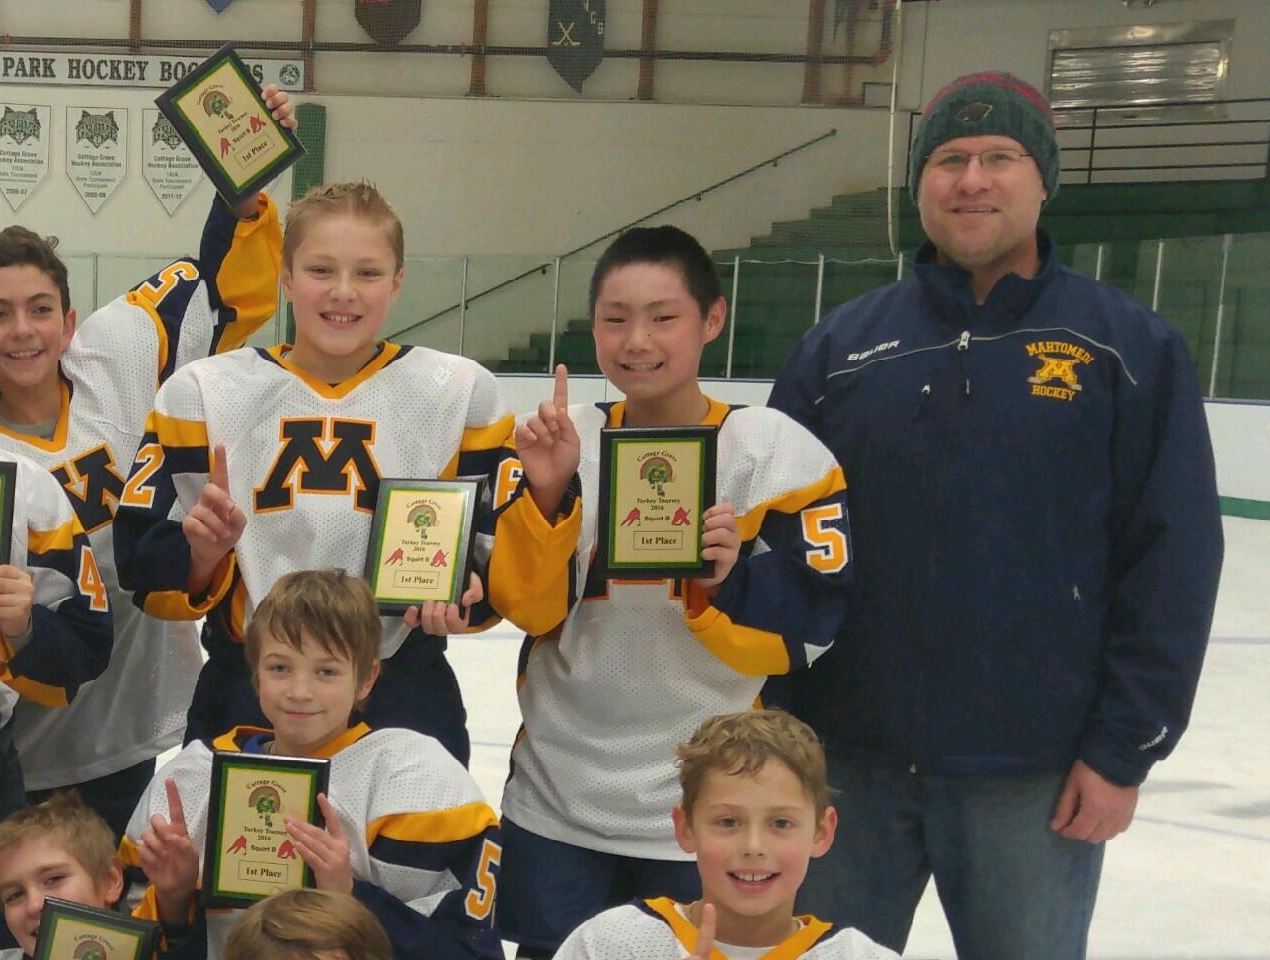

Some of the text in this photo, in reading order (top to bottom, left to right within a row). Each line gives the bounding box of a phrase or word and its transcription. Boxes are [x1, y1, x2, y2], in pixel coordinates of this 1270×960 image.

[2, 57, 149, 82] PARK HOCKEY
[242, 141, 268, 162] 1st Place
[847, 340, 901, 361] BAUER
[1025, 341, 1095, 365] MAHTOMEDI
[1031, 384, 1076, 401] HOCKEY
[120, 442, 167, 510] 2
[253, 416, 382, 515] M
[656, 537, 677, 545] Place
[800, 502, 849, 575] 5
[77, 544, 108, 613] 4
[246, 867, 281, 878] 1st Place
[465, 838, 502, 920] 5
